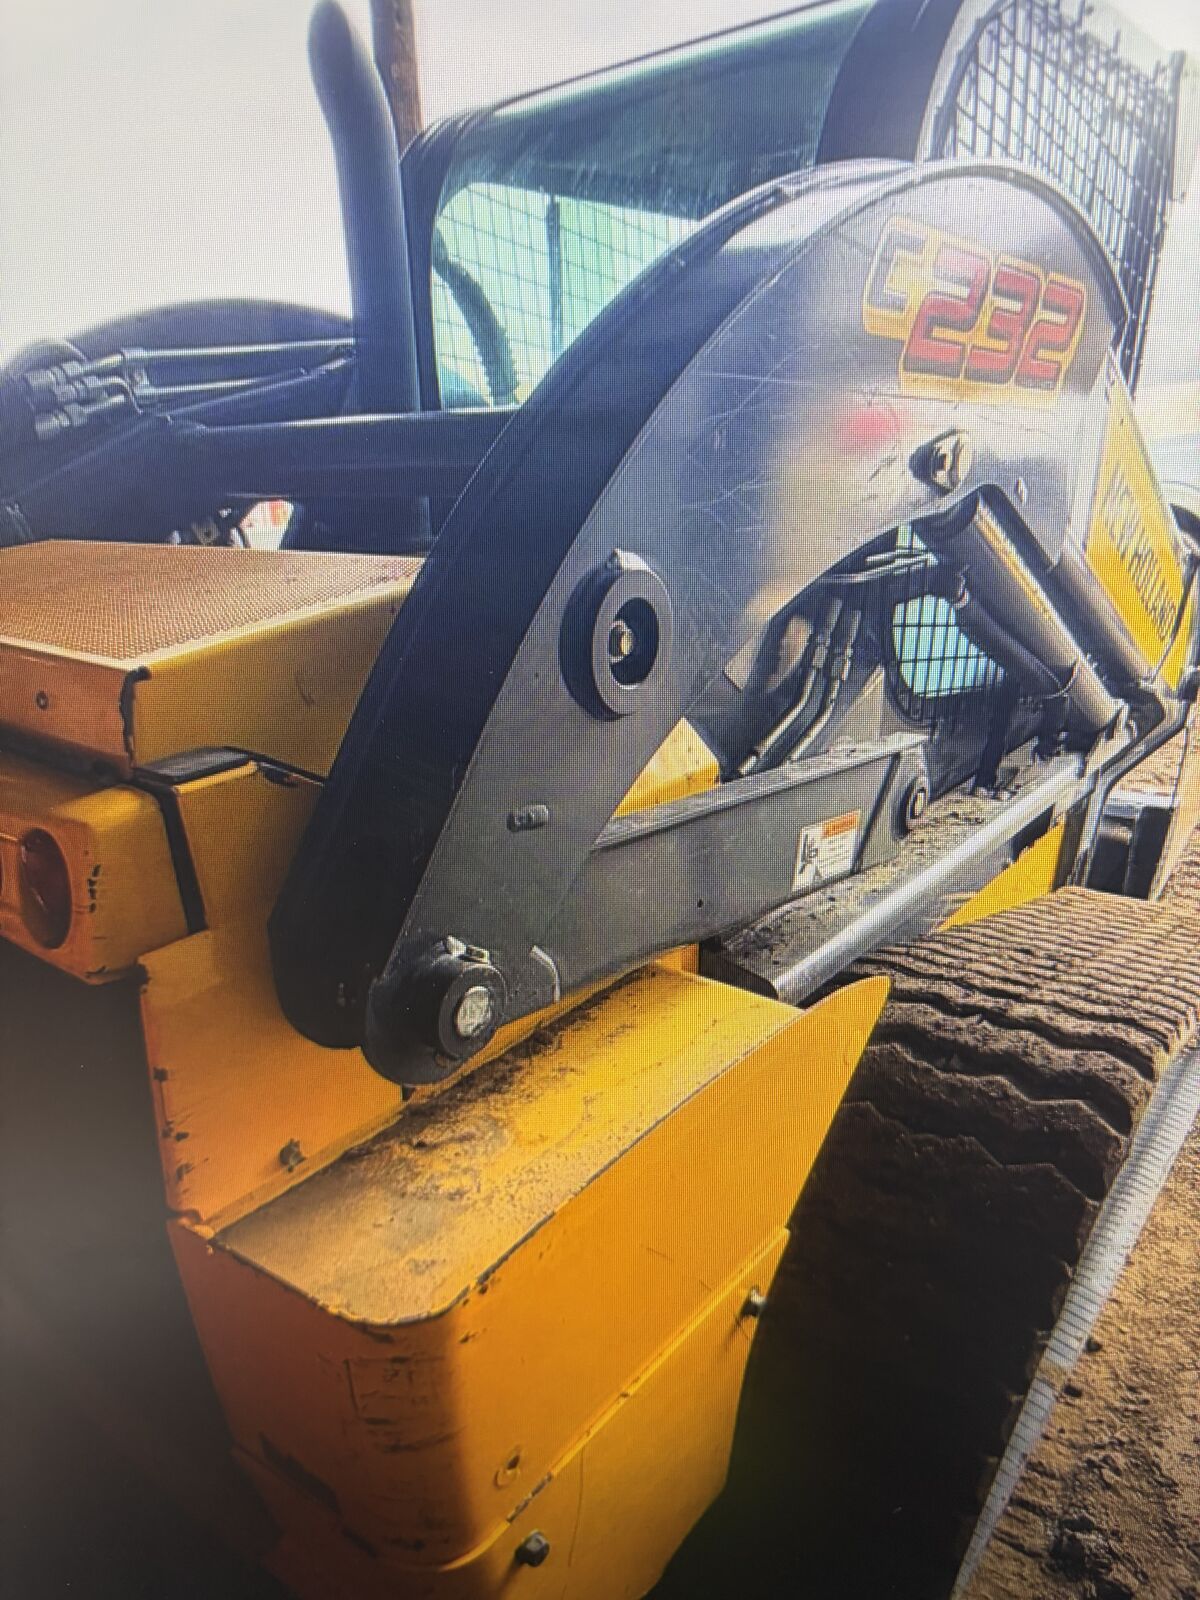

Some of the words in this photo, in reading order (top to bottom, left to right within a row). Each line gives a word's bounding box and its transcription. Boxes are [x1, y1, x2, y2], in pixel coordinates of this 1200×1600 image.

[865, 222, 1086, 395] C232
[1101, 460, 1143, 562] NEW
[1125, 526, 1177, 643] HOLLAND
